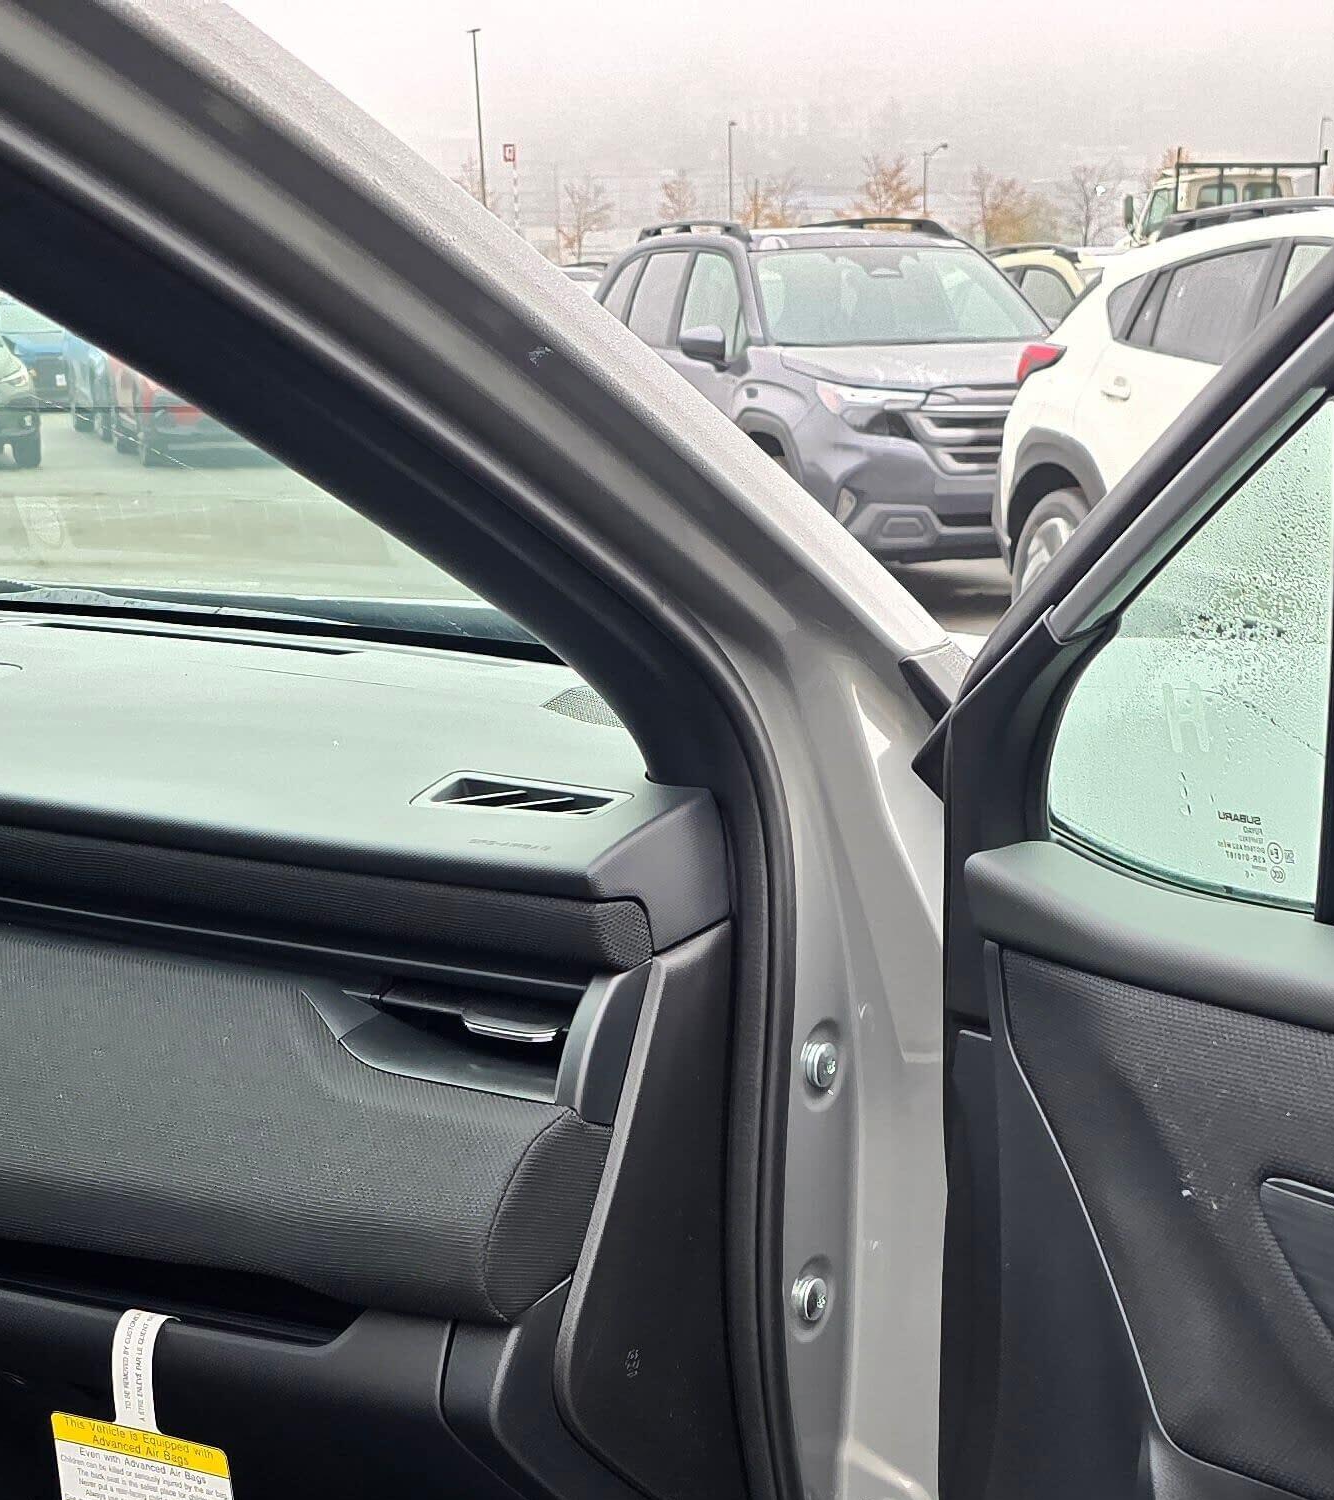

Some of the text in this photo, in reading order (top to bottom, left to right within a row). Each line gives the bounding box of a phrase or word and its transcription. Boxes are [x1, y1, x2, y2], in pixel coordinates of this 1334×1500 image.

[123, 1345, 130, 1356] BY
[64, 1416, 214, 1459] This Vehicle is Equipped with
[92, 1434, 189, 1466] Advanced Air Bags
[77, 1467, 90, 1476] The
[79, 1447, 207, 1485] Even with Advanced Air Bags
